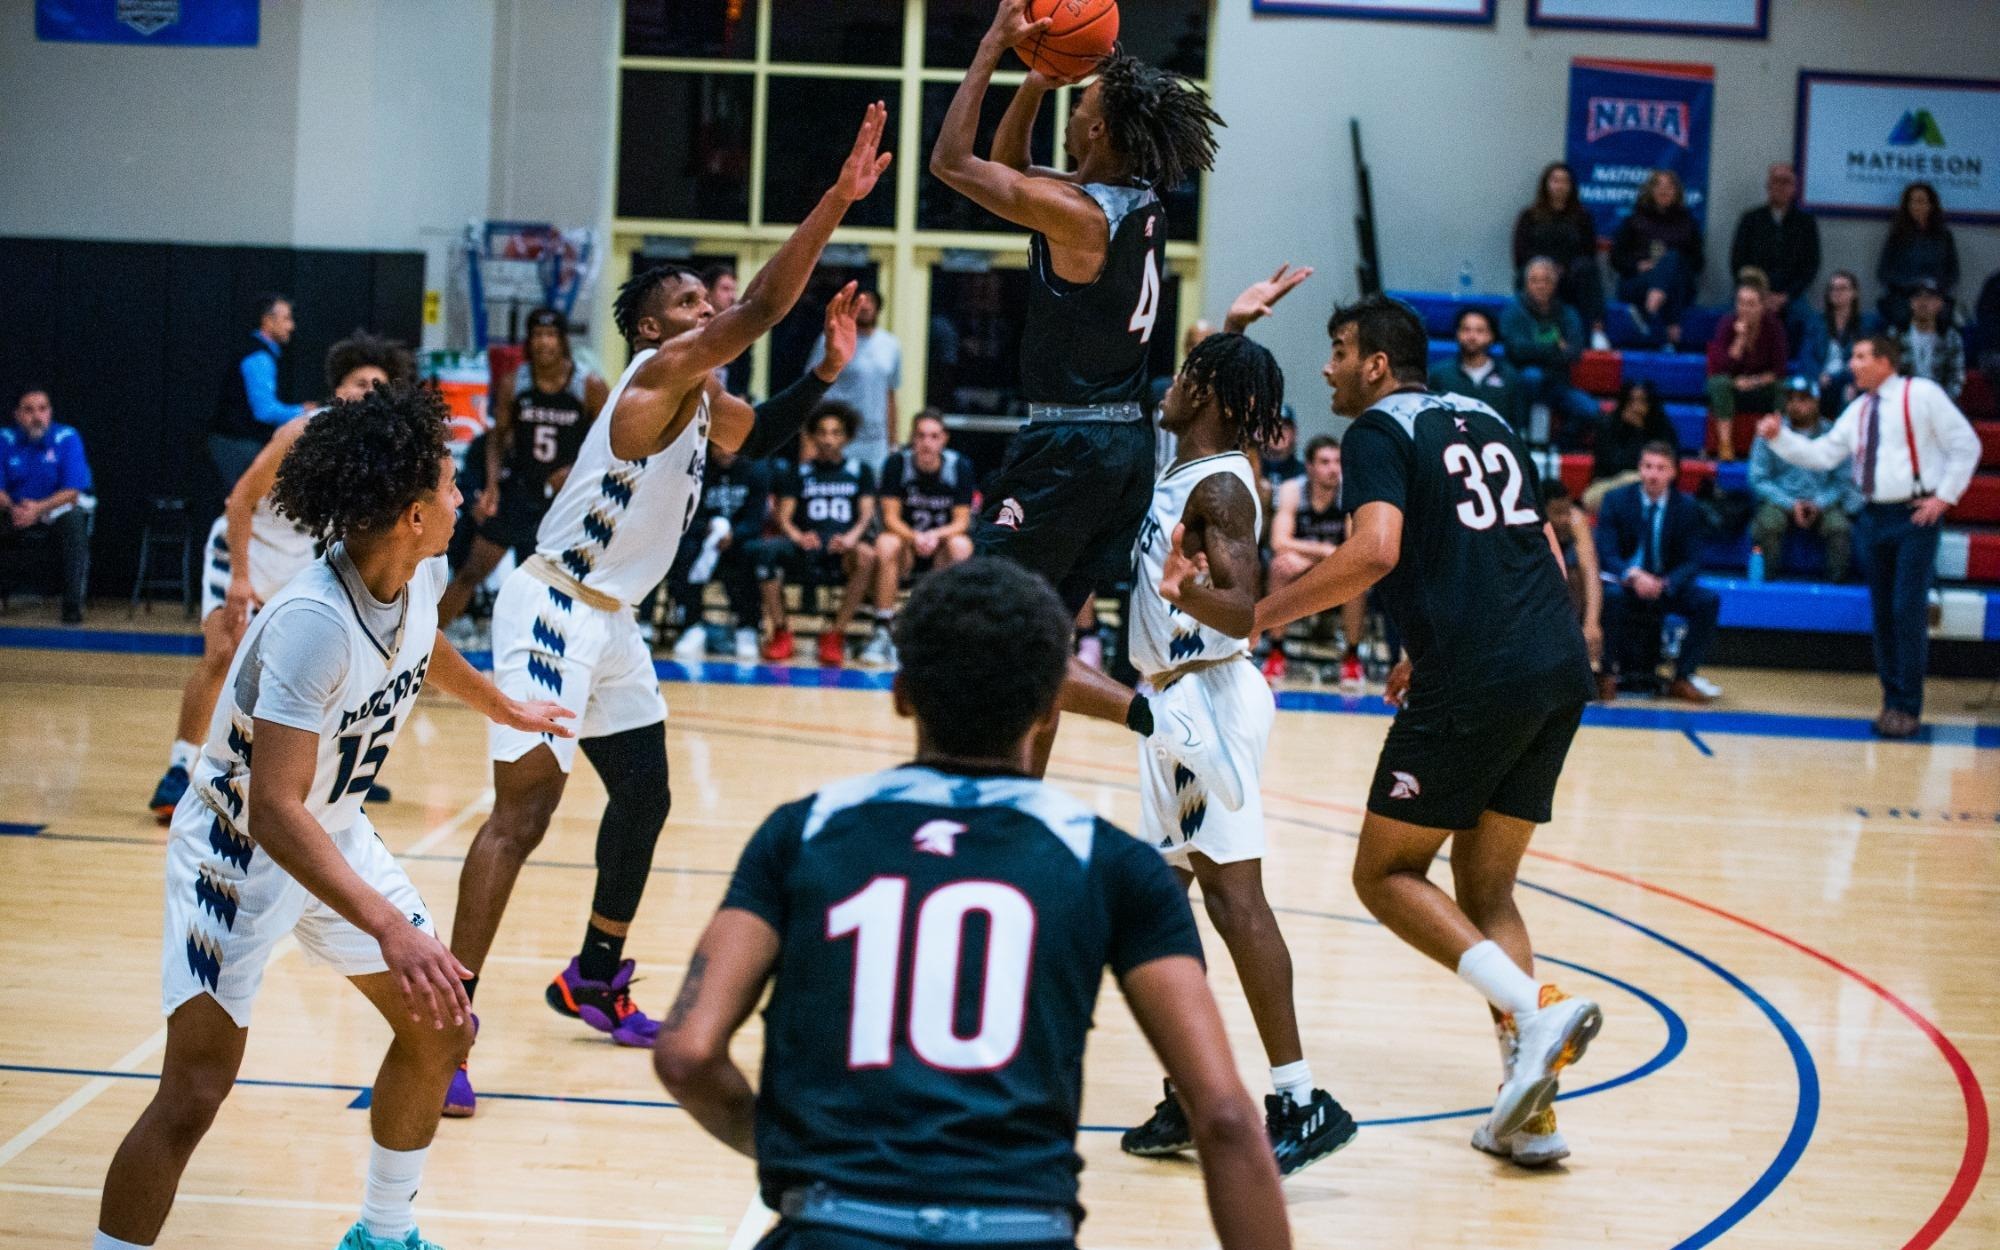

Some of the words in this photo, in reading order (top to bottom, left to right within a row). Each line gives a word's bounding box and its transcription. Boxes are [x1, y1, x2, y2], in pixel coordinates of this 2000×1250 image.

[1594, 102, 1682, 138] NAIA
[1847, 152, 1981, 175] MATHESON
[1128, 249, 1160, 344] 4
[532, 424, 558, 463] 5
[1443, 441, 1540, 531] 32
[327, 716, 396, 804] 15
[826, 876, 1036, 1073] 10
